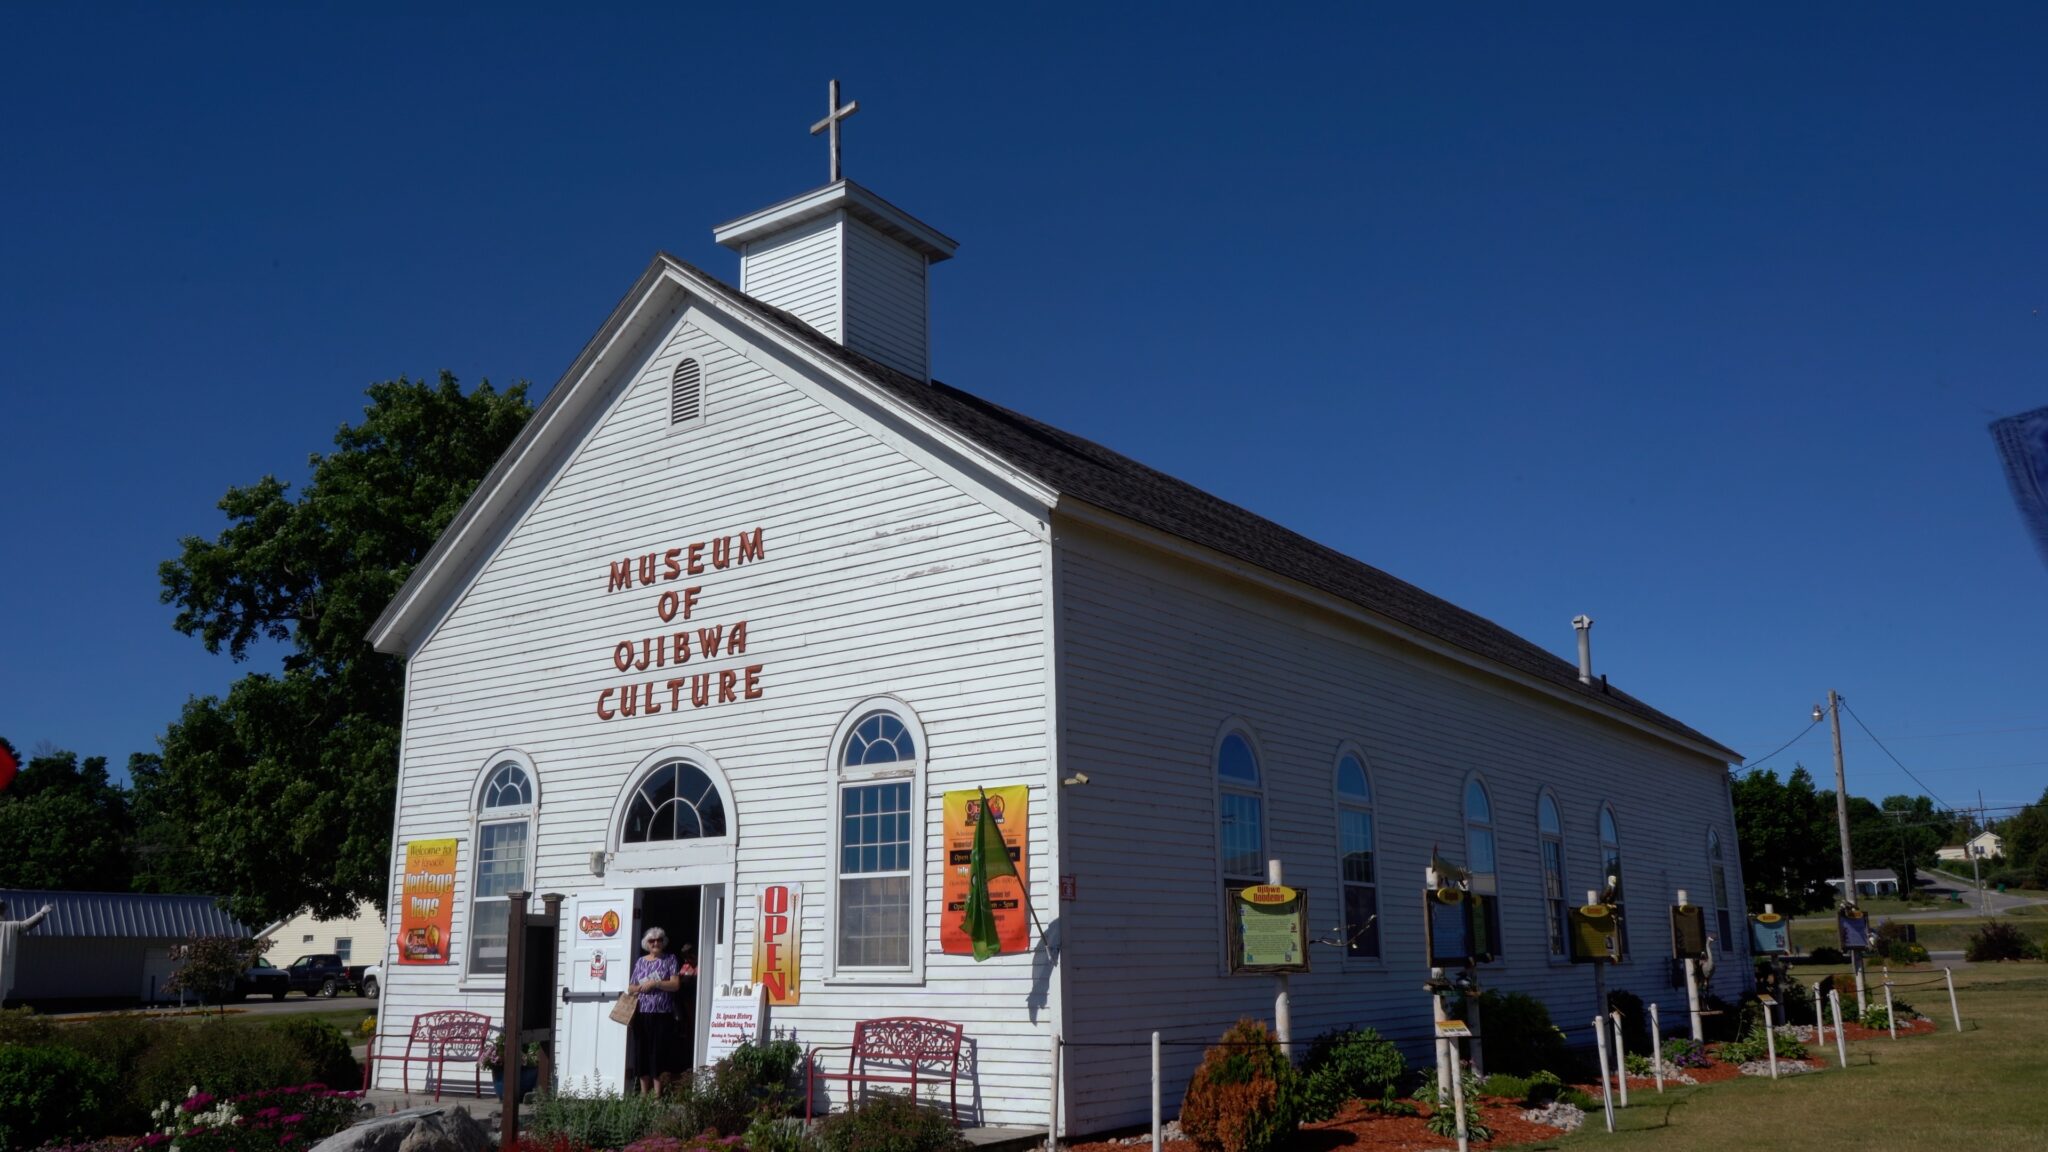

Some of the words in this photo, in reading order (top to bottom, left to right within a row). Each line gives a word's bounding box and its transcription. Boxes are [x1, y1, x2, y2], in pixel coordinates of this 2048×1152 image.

[608, 527, 765, 593] MUSEUM
[658, 586, 702, 623] OF
[614, 620, 747, 672] OJIBWA
[597, 664, 764, 720] CULTURE
[410, 845, 441, 856] Welcome
[406, 871, 452, 896] Heritage
[411, 896, 439, 920] Days
[763, 886, 788, 1001] OPEN
